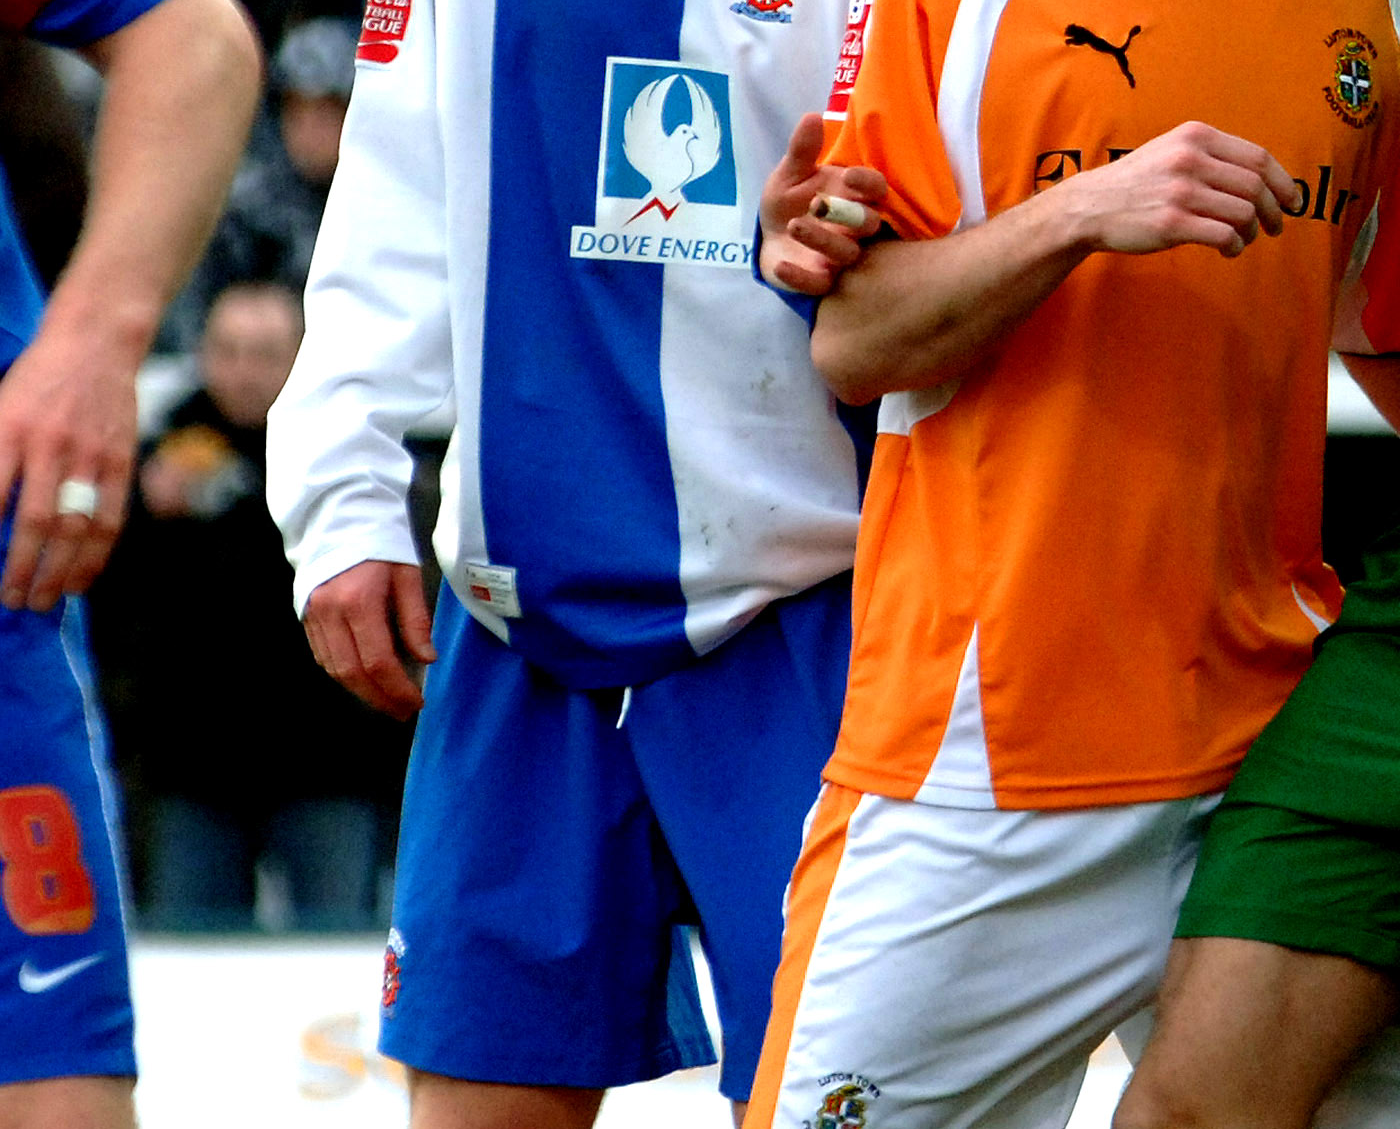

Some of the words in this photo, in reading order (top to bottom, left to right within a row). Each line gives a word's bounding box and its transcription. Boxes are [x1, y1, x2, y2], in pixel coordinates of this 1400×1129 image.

[576, 232, 652, 256] DOVE
[658, 237, 753, 264] ENERGY
[0, 784, 95, 936] 8
[818, 1072, 853, 1087] LUTON
